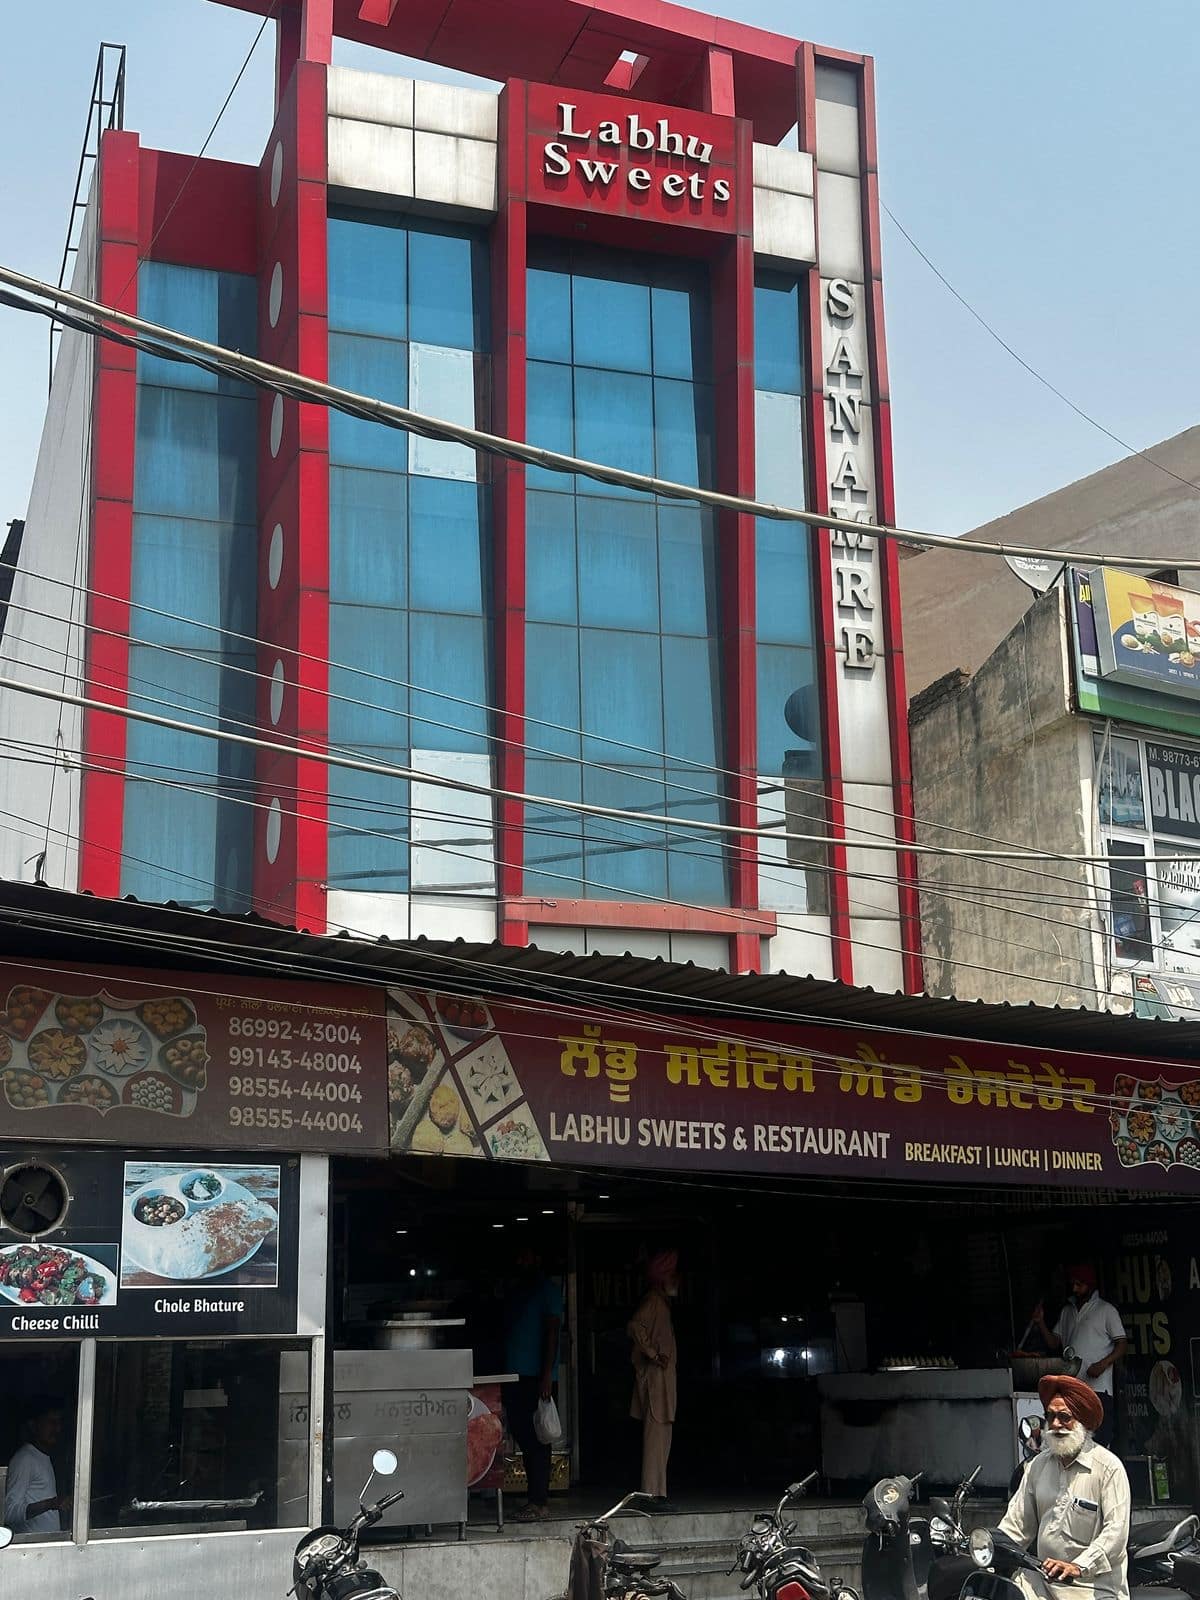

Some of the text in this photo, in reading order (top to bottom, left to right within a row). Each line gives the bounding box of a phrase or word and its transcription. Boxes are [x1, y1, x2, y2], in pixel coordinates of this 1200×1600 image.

[557, 102, 714, 164] Labhu
[544, 142, 732, 204] Sweets
[826, 278, 876, 670] SANAMRE
[1149, 747, 1200, 768] M. 98773-6
[228, 1016, 362, 1046] 86992-43004
[229, 1046, 362, 1075] 99143-48004
[663, 1041, 816, 1093] ਸਵੀਟਸ
[229, 1077, 363, 1104] 98554-44004
[229, 1107, 363, 1134] 98555-44004
[549, 1111, 891, 1159] LABHU SWEETS & RESTAURANT
[905, 1142, 982, 1165] BREAKFAST
[995, 1148, 1040, 1168] LUNCH
[1053, 1150, 1103, 1171] DINNER
[154, 1298, 245, 1314] Chole Bhature
[11, 1313, 100, 1332] Cheese Chilli
